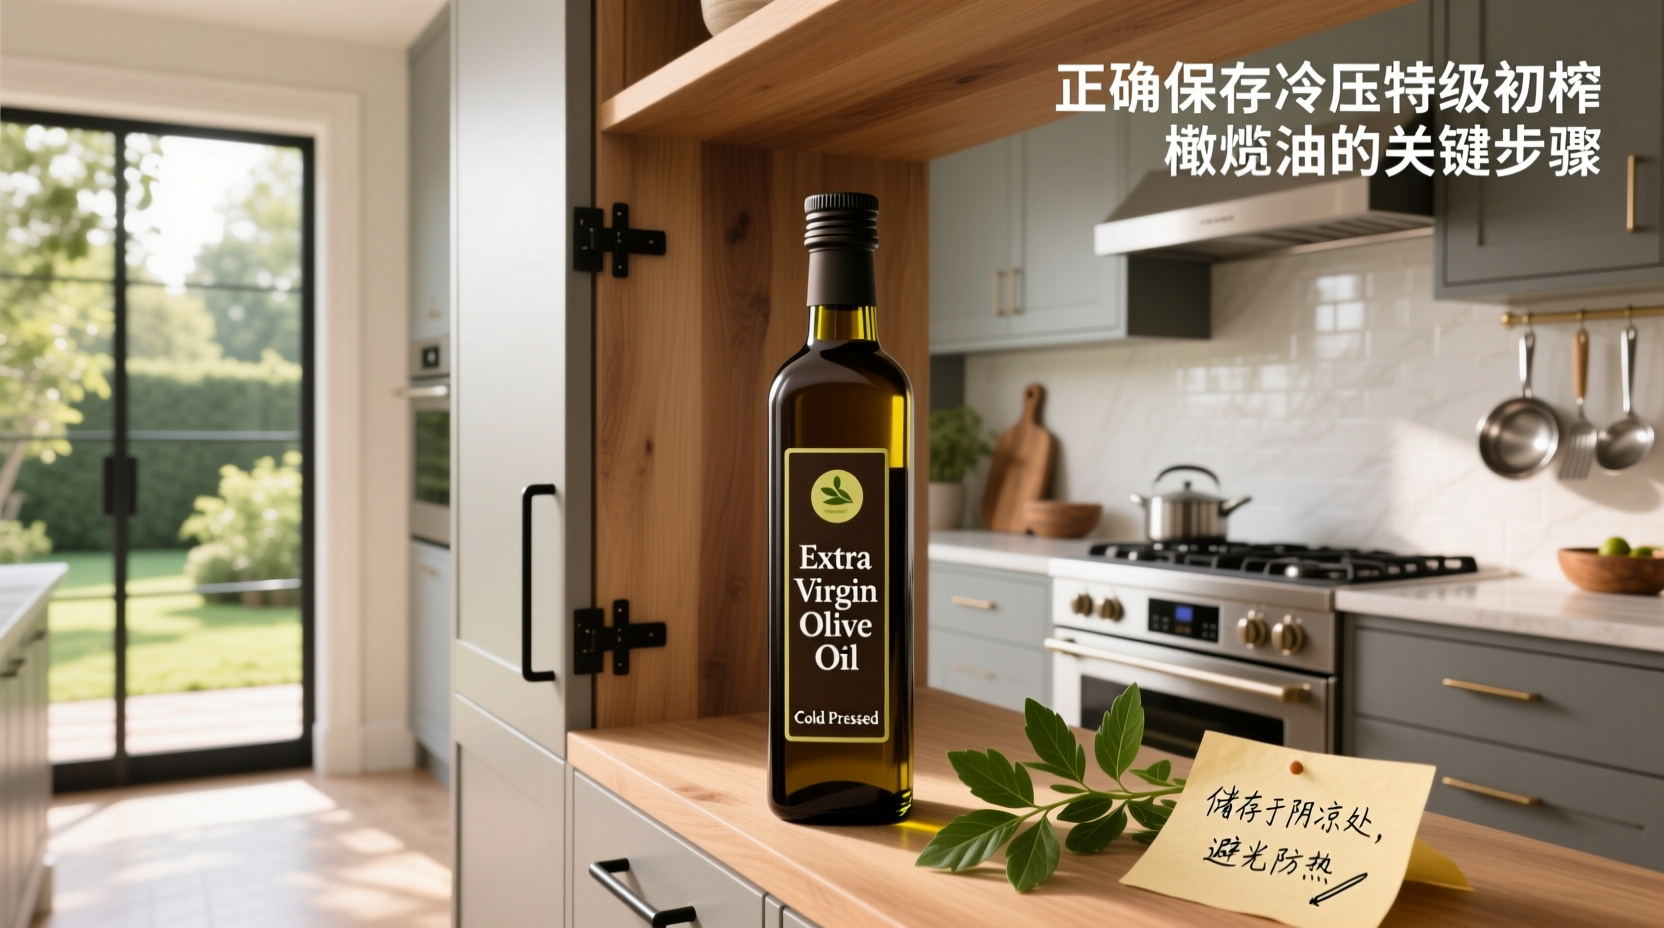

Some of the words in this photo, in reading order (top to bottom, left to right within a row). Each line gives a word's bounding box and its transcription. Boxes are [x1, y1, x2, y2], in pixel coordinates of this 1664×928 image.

[799, 544, 873, 570] Extra
[793, 577, 878, 611] Virgin
[799, 610, 873, 638] Olive
[815, 643, 859, 671] Oil
[794, 710, 826, 725] Cold
[1203, 836, 1332, 885] 避光防热
